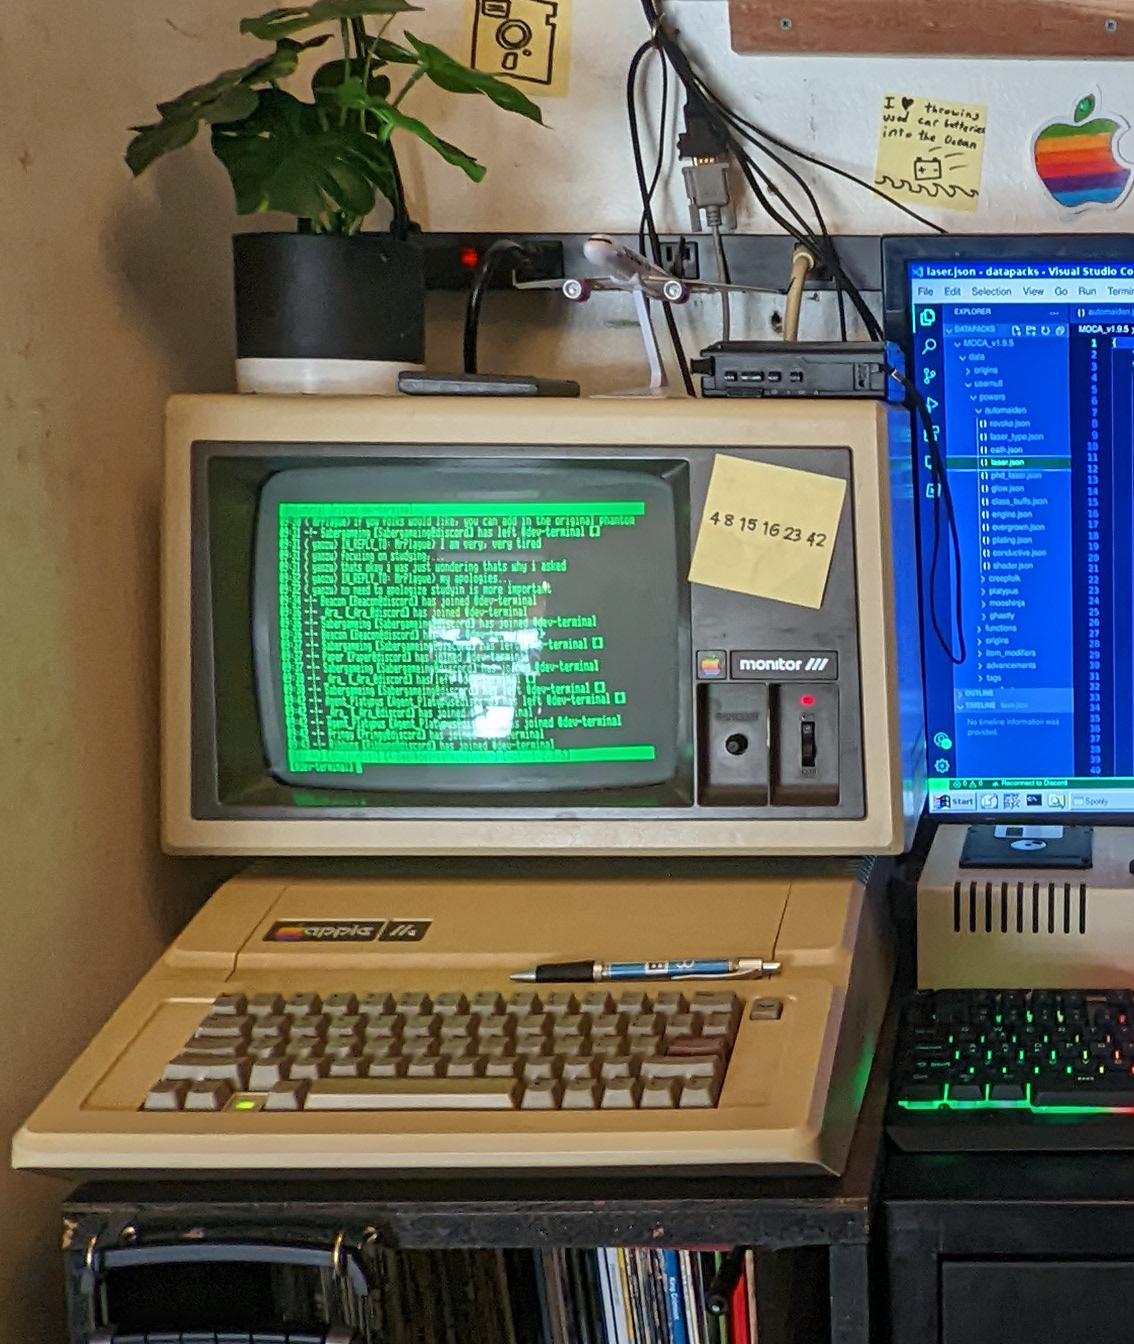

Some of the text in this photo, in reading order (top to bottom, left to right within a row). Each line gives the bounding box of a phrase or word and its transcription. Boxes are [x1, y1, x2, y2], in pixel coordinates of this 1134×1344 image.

[884, 97, 980, 121] I throwing
[883, 111, 986, 134] used car batteries
[883, 126, 912, 138] into
[918, 130, 936, 142] the
[926, 267, 976, 278] laser.json
[986, 267, 1039, 278] datapacks
[1049, 267, 1080, 276] Visual
[1083, 267, 1117, 276] Studio
[918, 287, 934, 296] File
[944, 287, 961, 296] Edit
[971, 287, 1012, 296] Selection
[1023, 287, 1044, 296] View
[1055, 287, 1068, 296] Go
[1078, 287, 1096, 296] Run
[710, 512, 828, 548] 4 8 15 16 23 42
[740, 658, 802, 672] monitor
[952, 797, 973, 806] Start
[305, 924, 374, 938] apple
